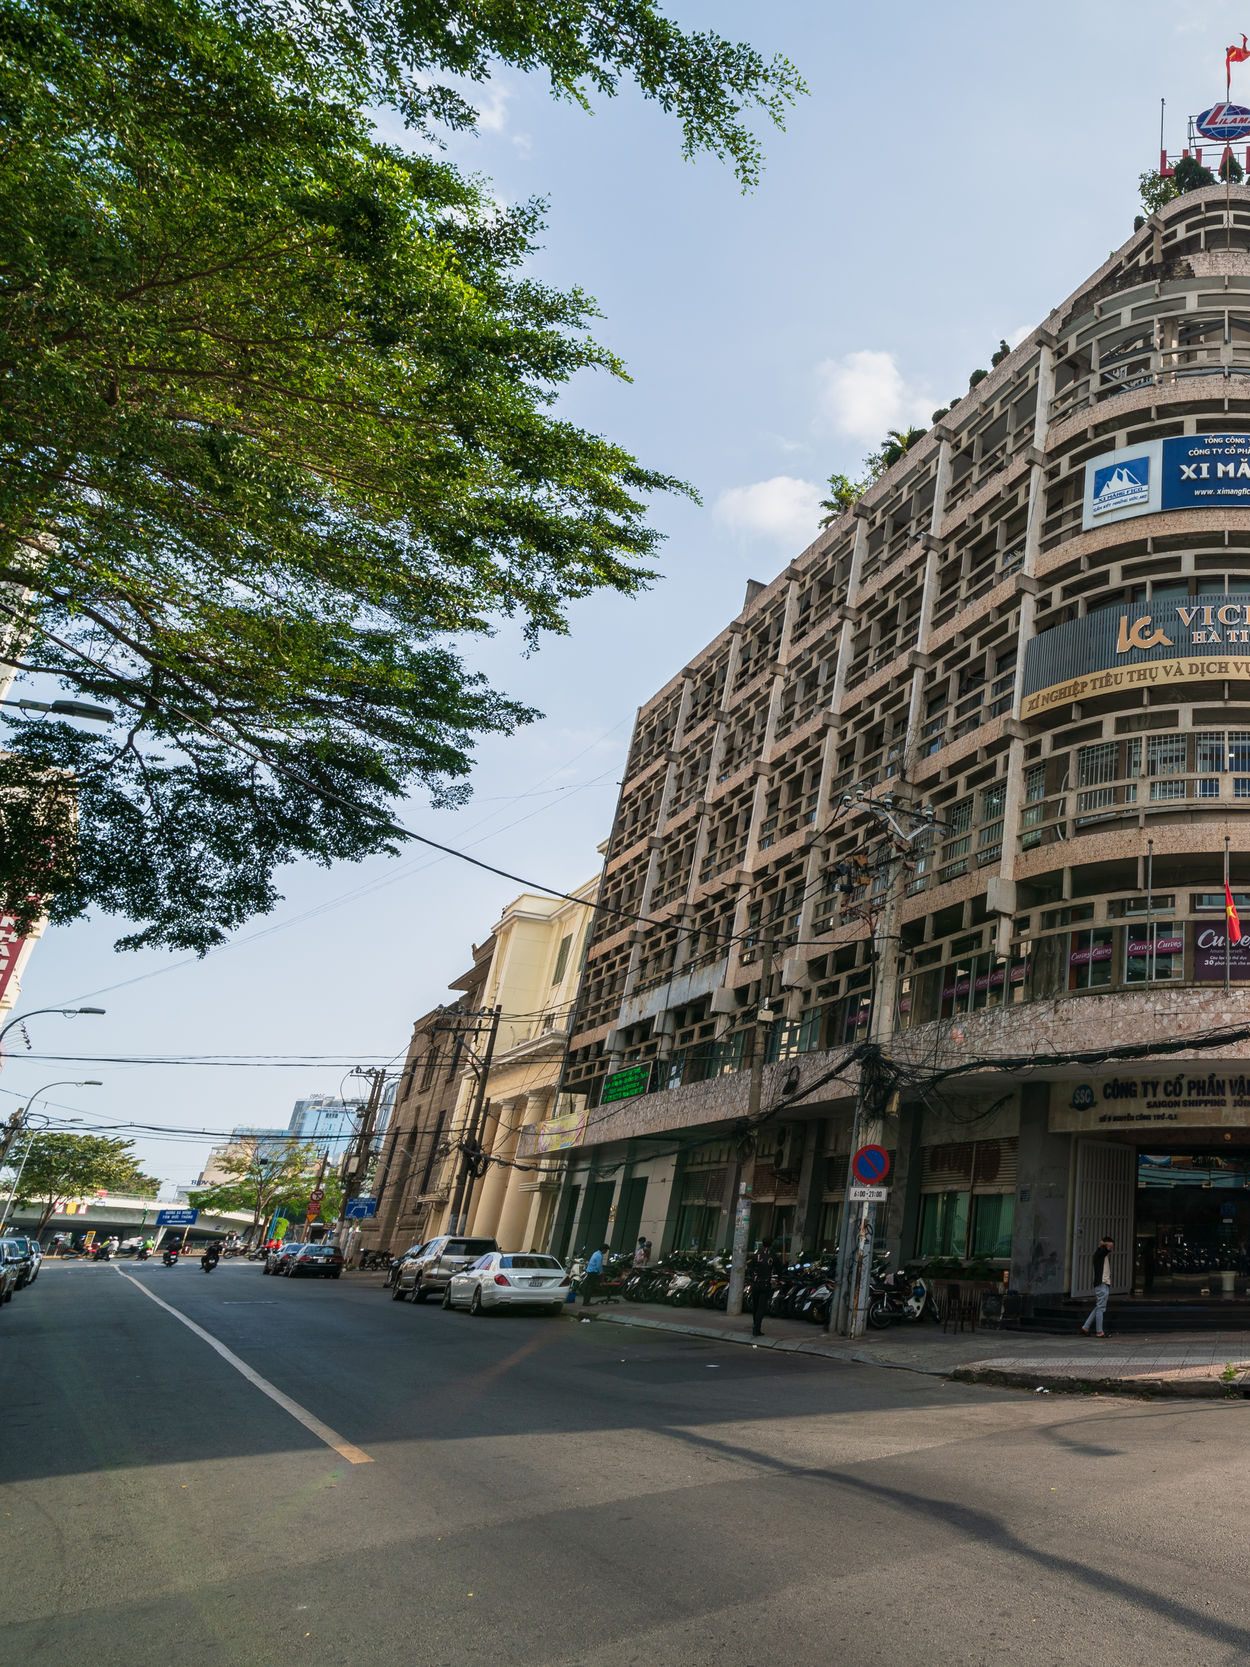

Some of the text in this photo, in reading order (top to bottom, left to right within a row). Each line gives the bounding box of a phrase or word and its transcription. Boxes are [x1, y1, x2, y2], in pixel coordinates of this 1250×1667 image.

[1225, 436, 1245, 444] CÔNG
[1188, 447, 1210, 456] CÔNG
[1179, 463, 1210, 481] XI
[1191, 626, 1221, 645] HÀ
[1027, 694, 1041, 712] XÍ
[1041, 681, 1088, 706] NGHIỆP
[1090, 672, 1124, 690] TIÊU
[1127, 667, 1158, 684] THỤ
[1162, 662, 1184, 677] VÀ
[1188, 661, 1229, 677] DỊCH
[1103, 1078, 1137, 1099] CÔNG
[1141, 1081, 1159, 1098] TY
[1163, 1073, 1184, 1098] CỔ
[1187, 1073, 1225, 1097] PHẦN
[1074, 1089, 1090, 1104] SSC
[1146, 1100, 1180, 1108] SAIGON
[1182, 1099, 1226, 1107] SHIPPING
